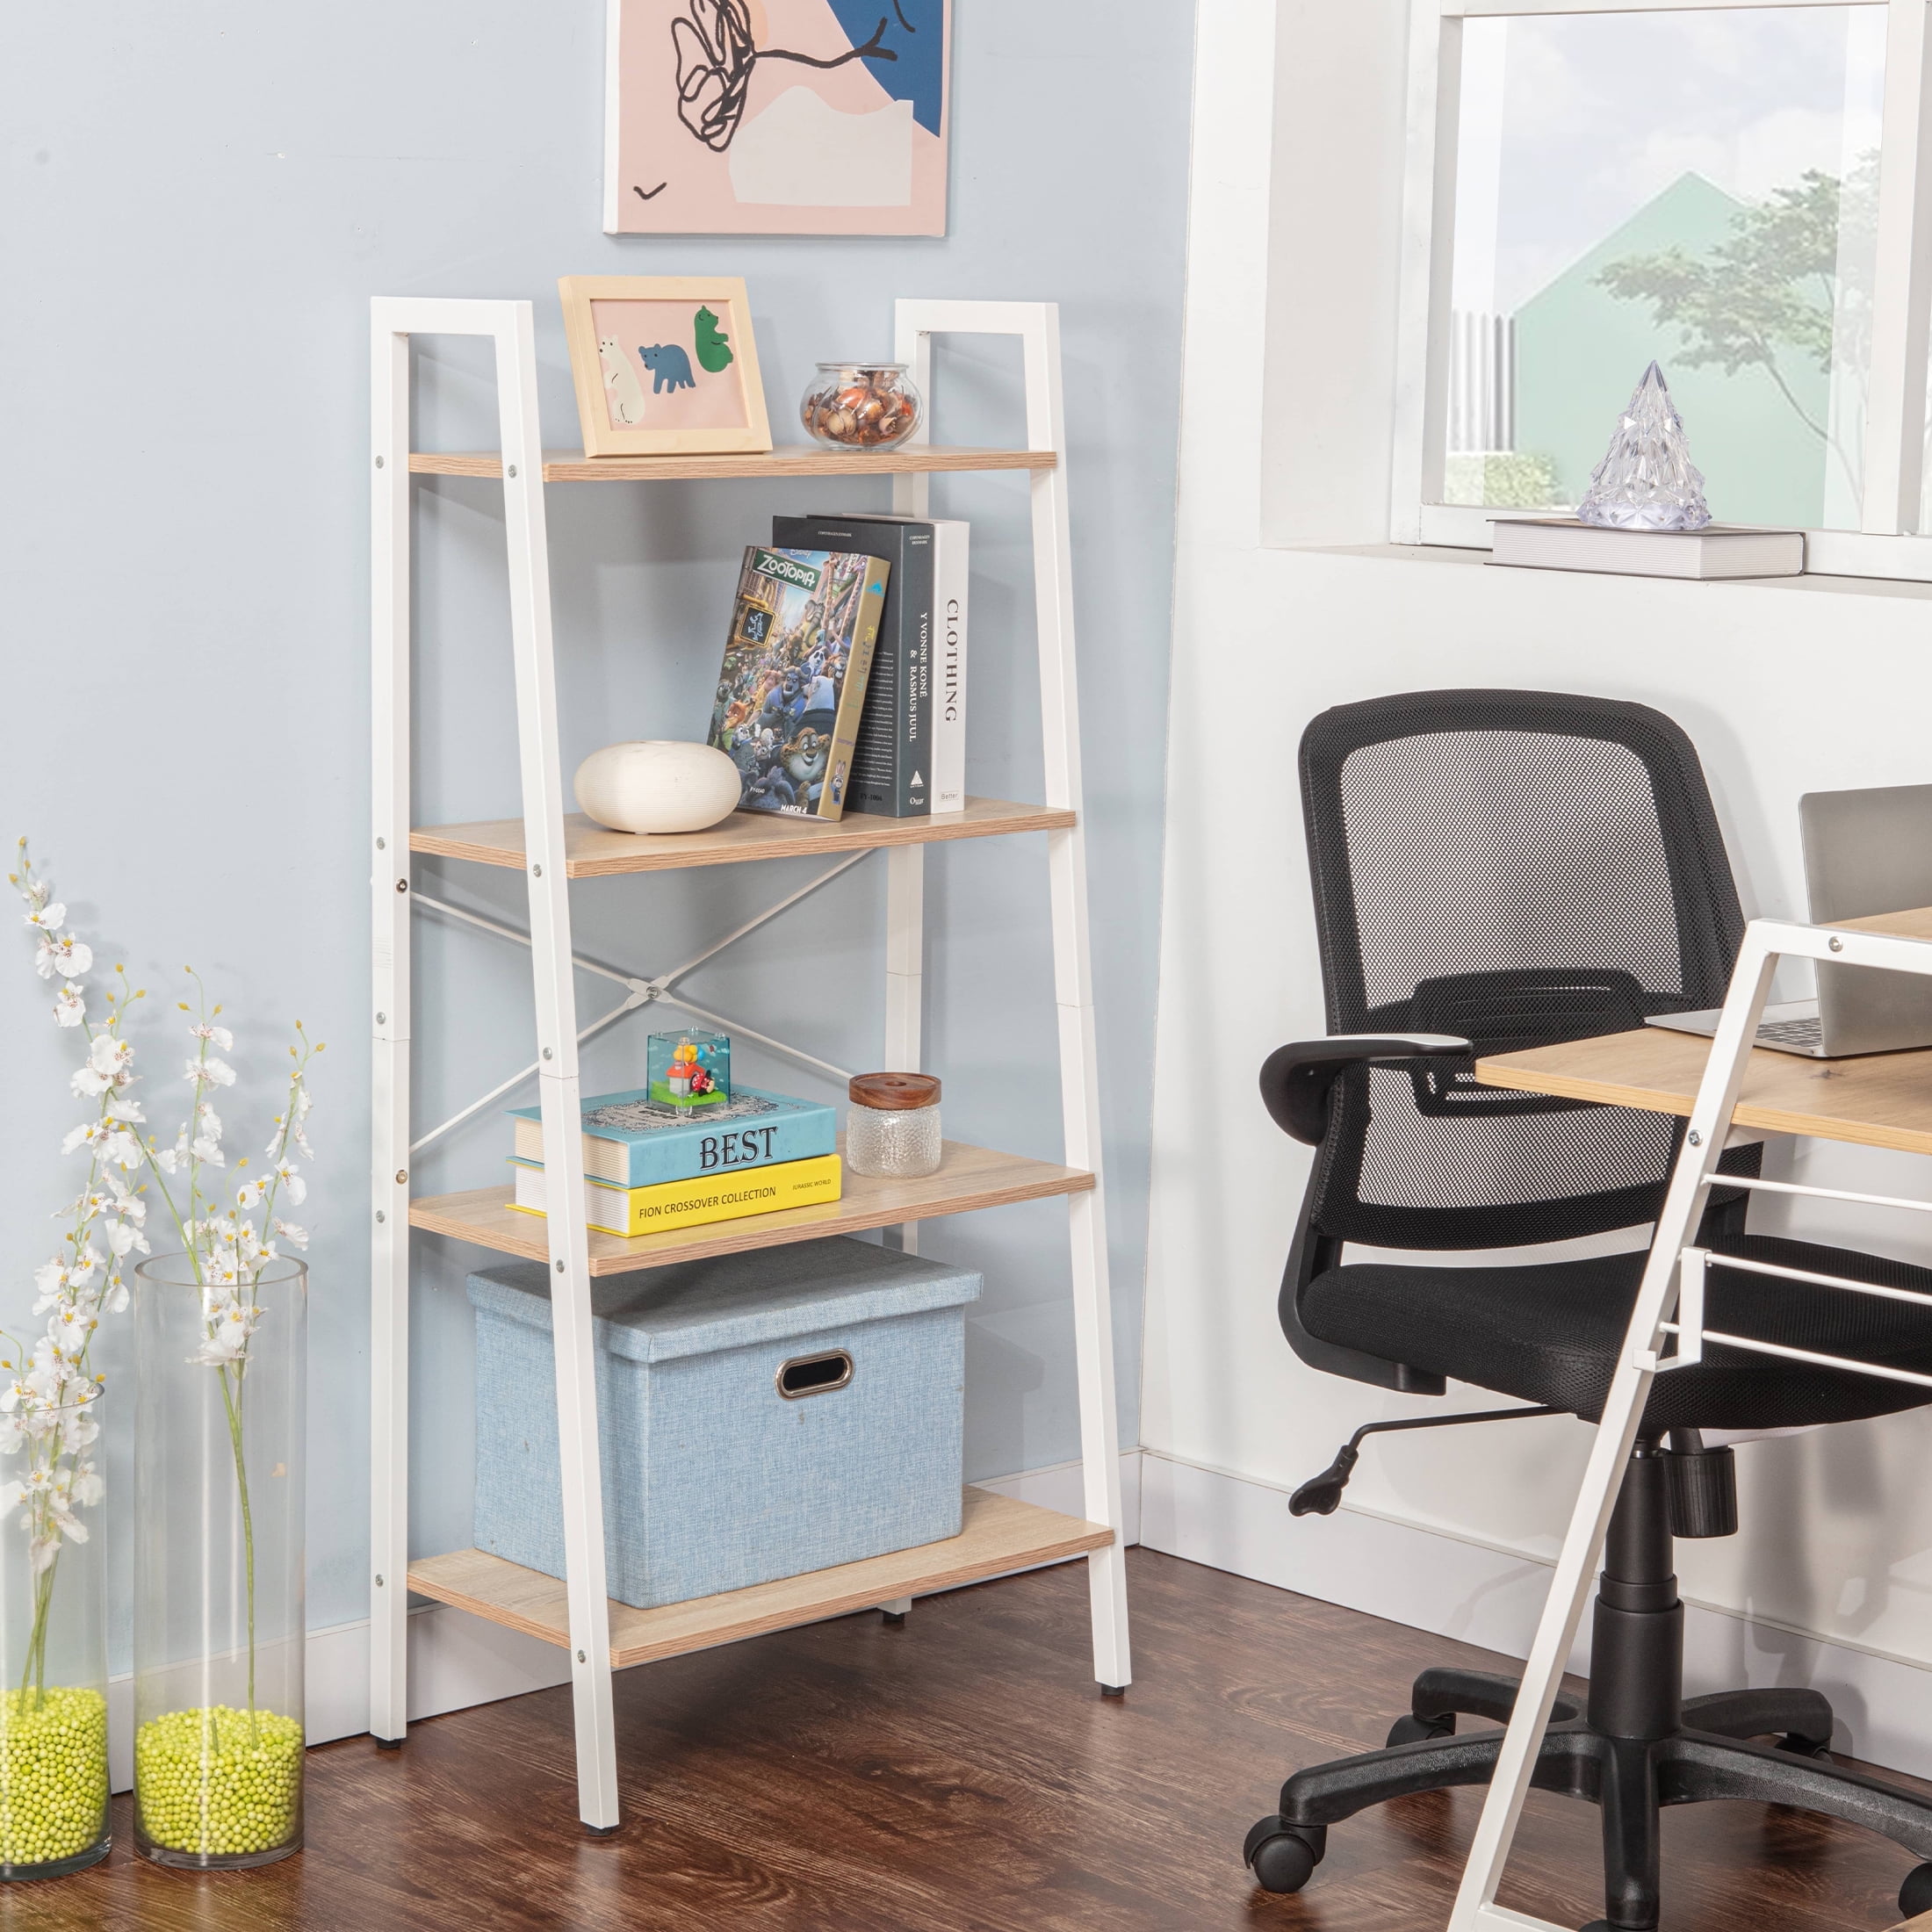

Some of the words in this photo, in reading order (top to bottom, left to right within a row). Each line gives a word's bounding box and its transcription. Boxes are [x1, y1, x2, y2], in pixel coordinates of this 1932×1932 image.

[910, 649, 918, 659] &
[946, 599, 959, 722] CLOTHING
[909, 666, 918, 712] RASMUS
[908, 713, 917, 742] JUUL
[781, 804, 802, 814] MARCH
[700, 1126, 778, 1171] BEST
[792, 1181, 813, 1191] JURASSIC
[814, 1179, 832, 1187] WORLD
[639, 1206, 661, 1219] FION
[664, 1195, 719, 1215] CROSSOVER
[721, 1186, 776, 1205] COLLECTION
